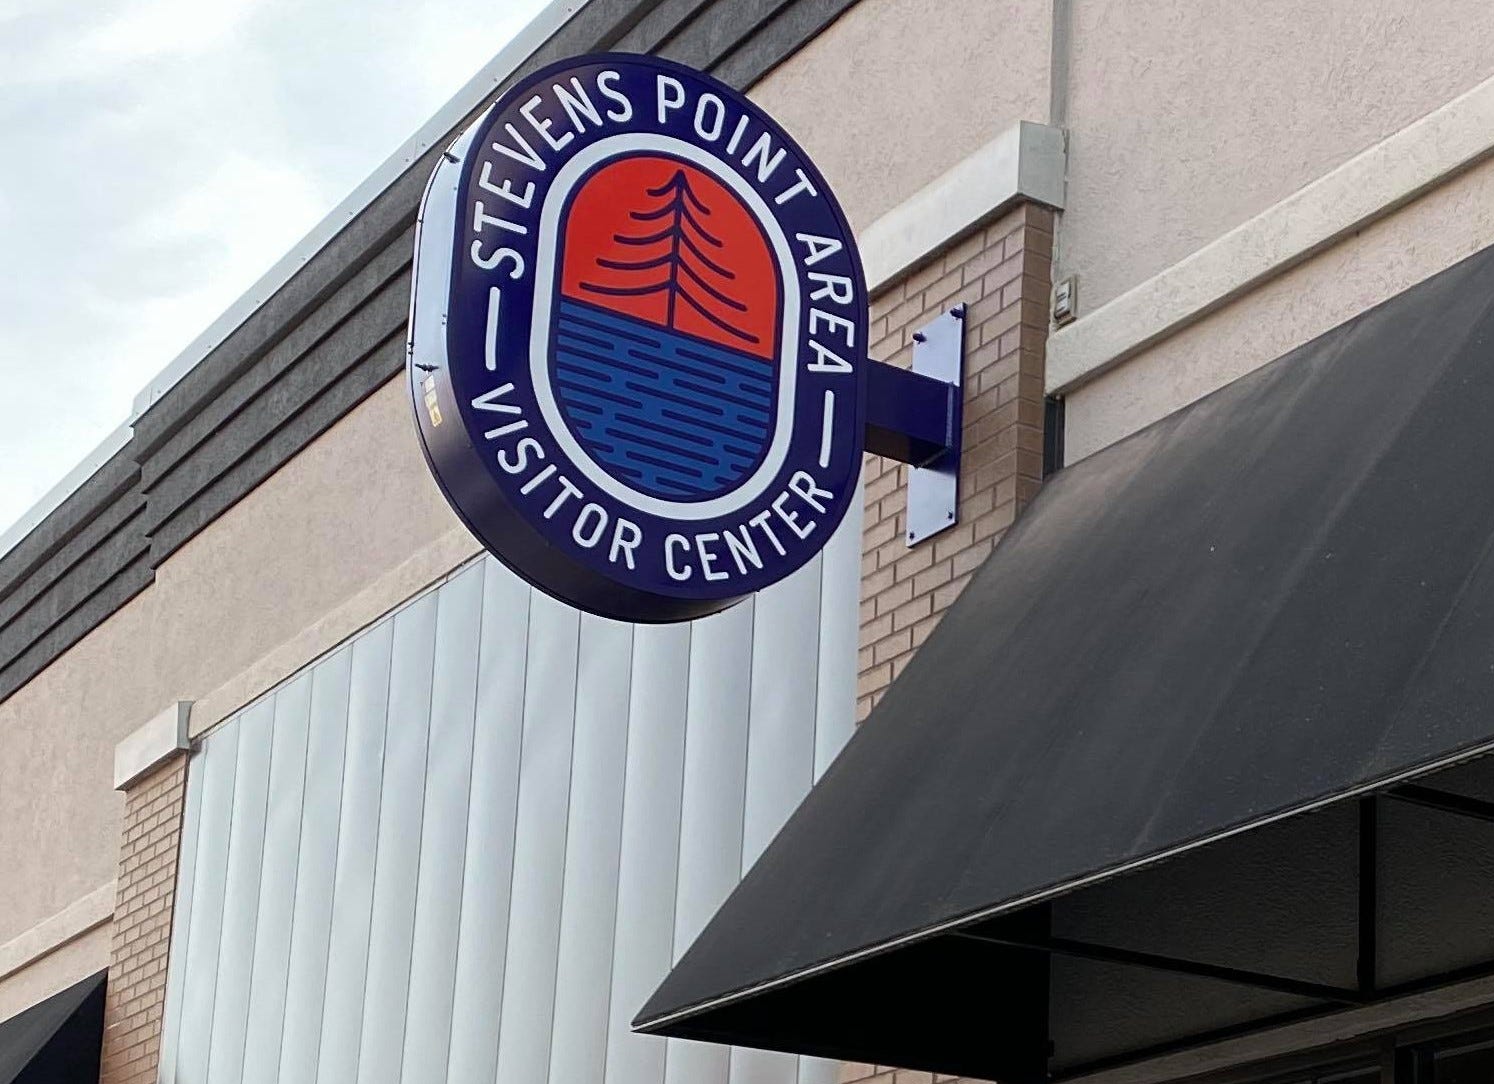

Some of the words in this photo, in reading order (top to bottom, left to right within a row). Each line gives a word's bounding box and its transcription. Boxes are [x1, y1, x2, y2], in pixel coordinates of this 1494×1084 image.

[471, 70, 634, 279] STEVENS
[656, 74, 817, 207] POINT
[795, 232, 855, 374] AREA
[471, 382, 643, 571] VISITOR
[664, 469, 835, 582] CENTER
